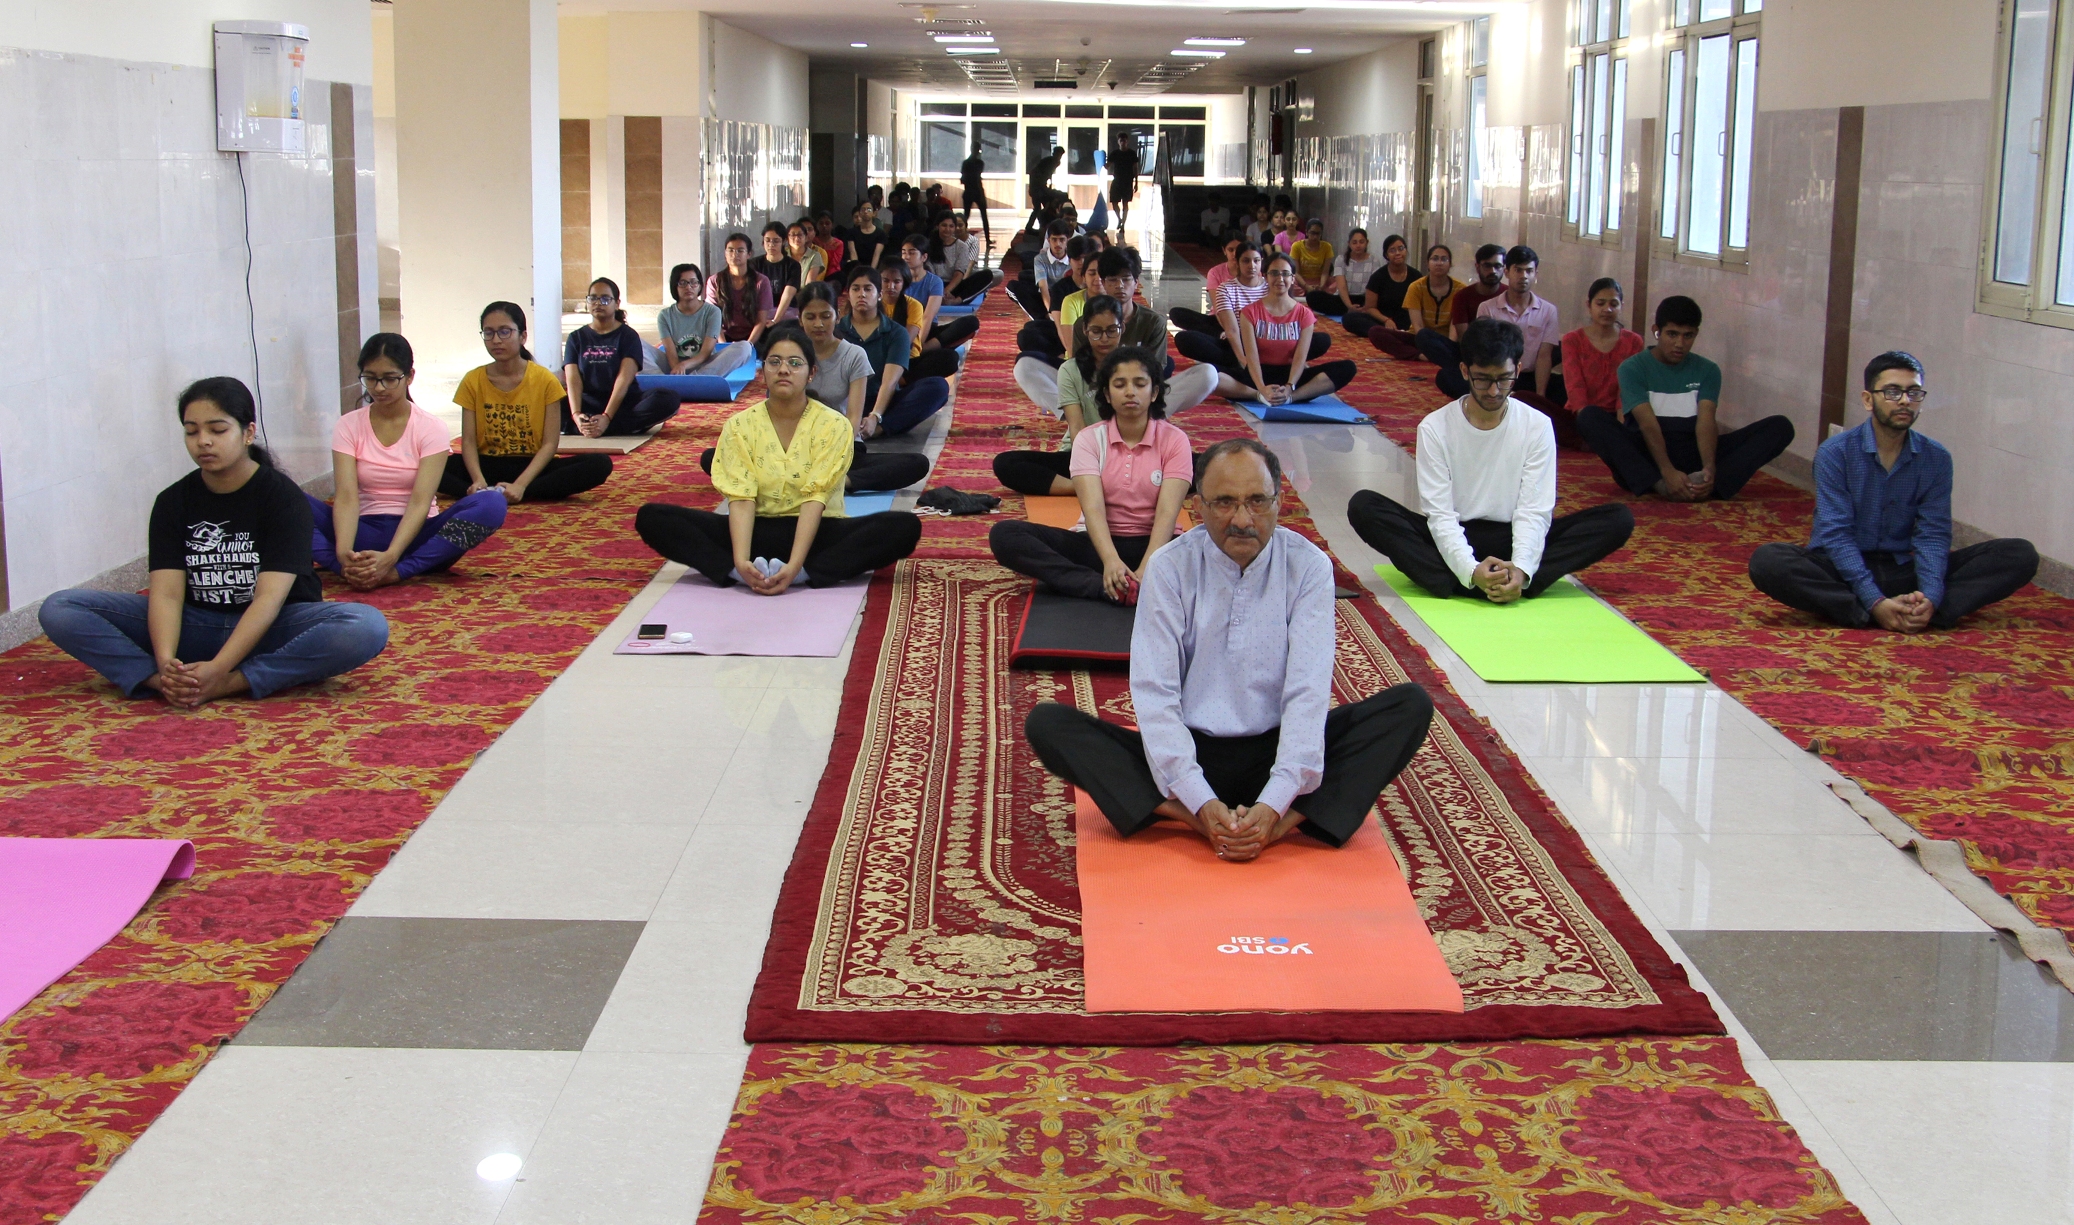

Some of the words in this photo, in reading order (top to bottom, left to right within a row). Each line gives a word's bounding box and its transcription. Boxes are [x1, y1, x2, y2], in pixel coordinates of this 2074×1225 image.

[234, 532, 250, 541] YOU
[185, 554, 221, 566] SHAKE
[223, 552, 260, 563] HANDS
[192, 589, 234, 604] FIST
[1230, 936, 1266, 944] SBI
[1216, 942, 1314, 955] yono
